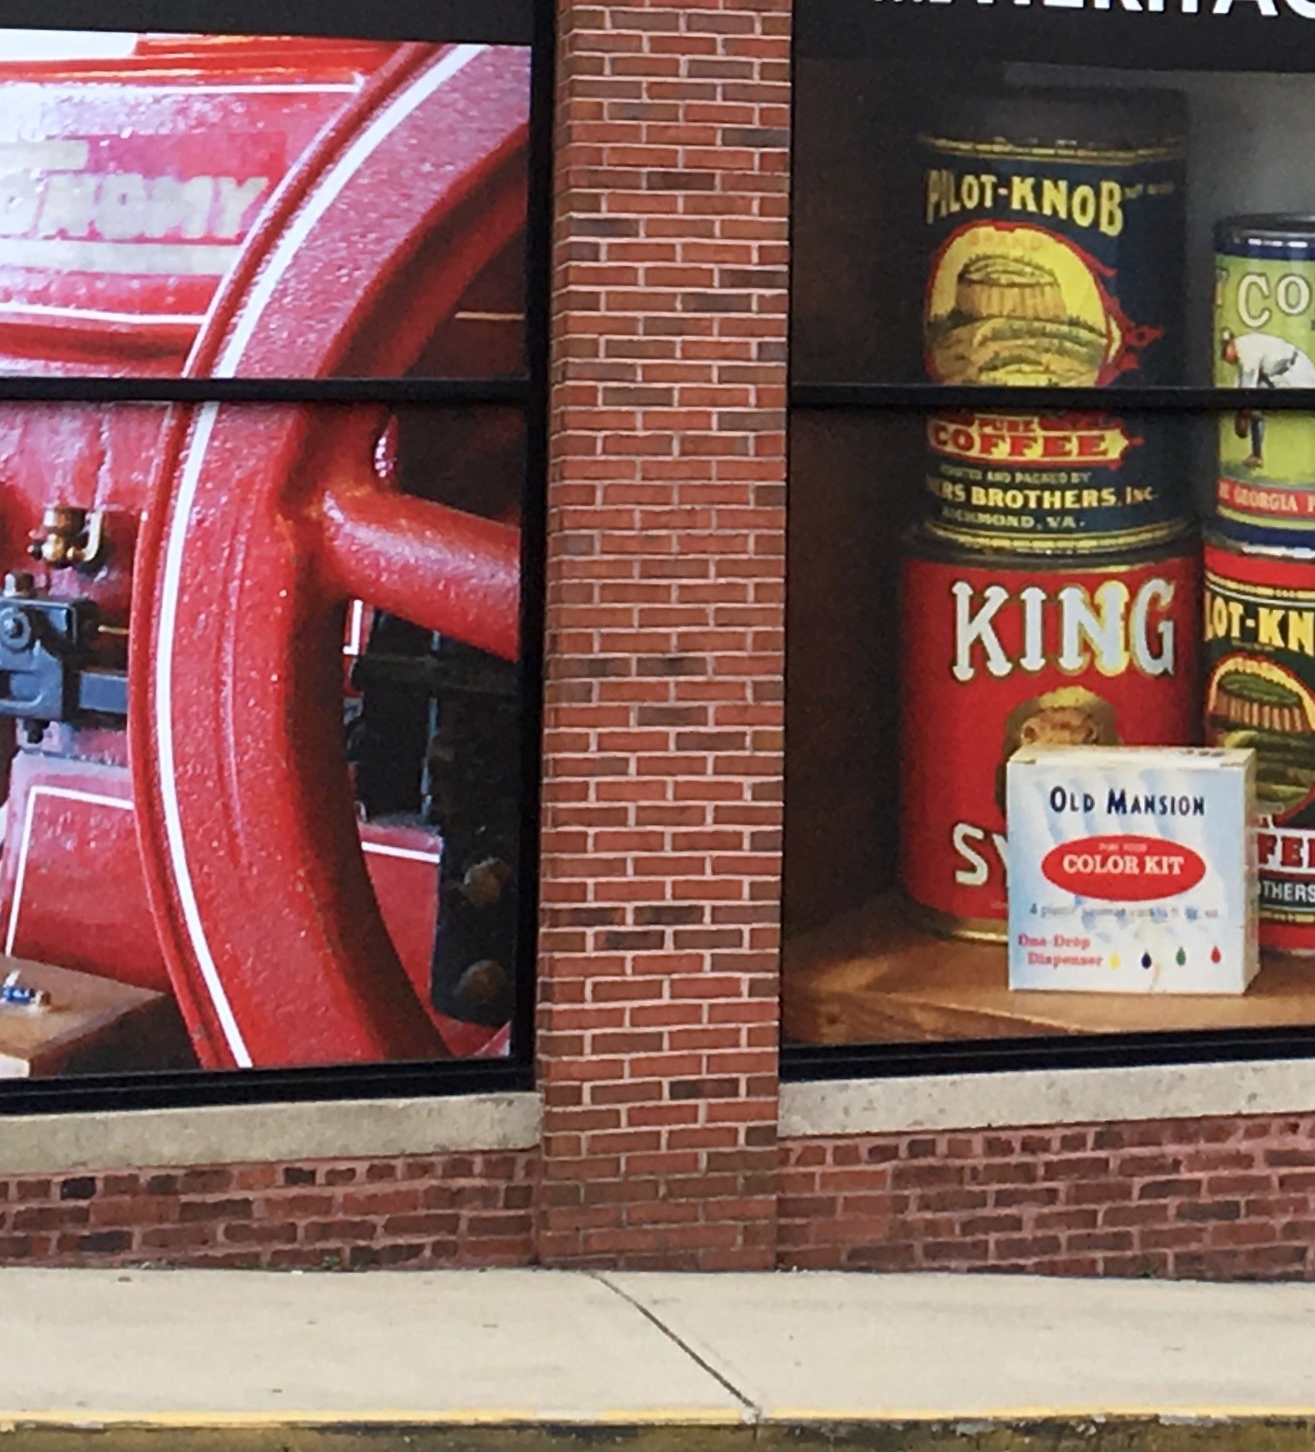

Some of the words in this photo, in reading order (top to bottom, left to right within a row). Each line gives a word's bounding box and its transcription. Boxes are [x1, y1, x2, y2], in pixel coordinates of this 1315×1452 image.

[926, 168, 1123, 236] PILOT-KNOB
[933, 424, 1108, 458] COFFEE
[1233, 484, 1299, 512] GEORGIA
[951, 576, 1176, 683] KING
[1062, 854, 1140, 875] COLOR
[1144, 856, 1185, 876] KIT
